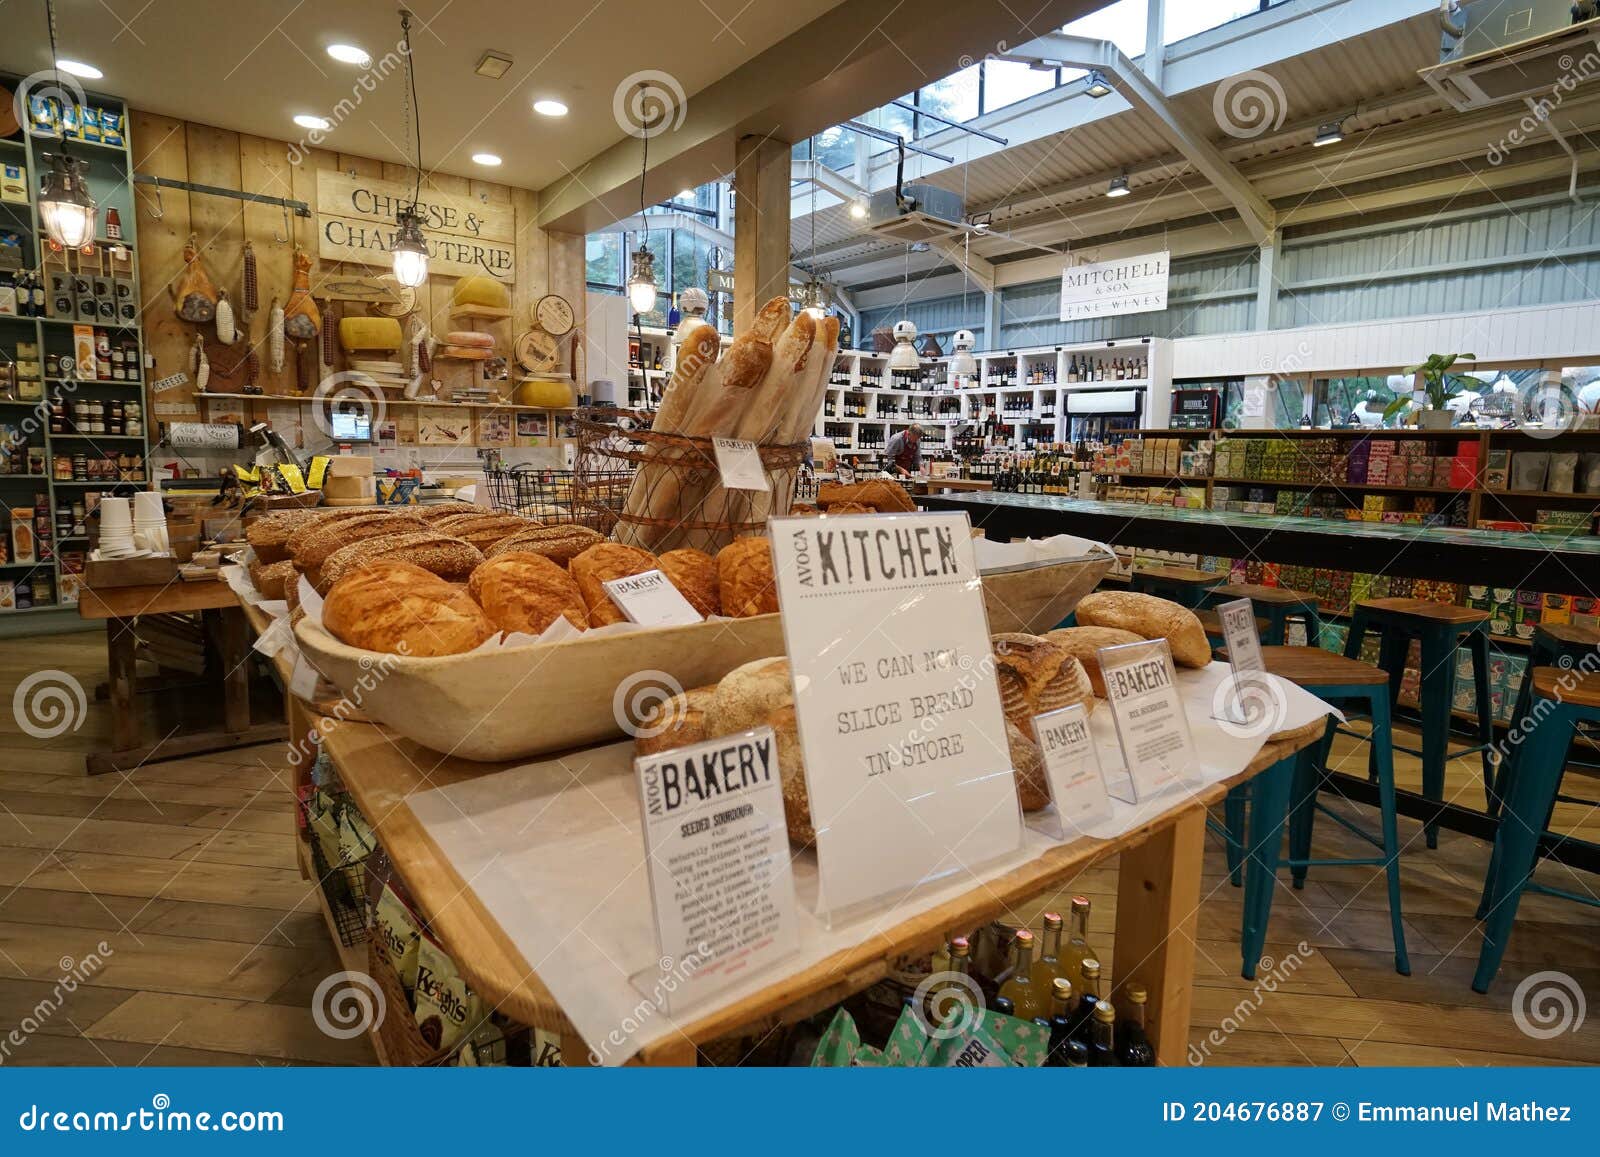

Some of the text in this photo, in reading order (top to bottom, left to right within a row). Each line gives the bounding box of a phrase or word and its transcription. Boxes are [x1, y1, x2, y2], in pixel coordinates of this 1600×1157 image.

[465, 212, 484, 236] &
[325, 221, 513, 277] CHAUTERIE
[1068, 261, 1166, 288] MITCHELL
[1107, 282, 1129, 293] SON
[1068, 296, 1161, 313] FINE WINES
[720, 440, 754, 450] BAKERY
[793, 526, 958, 588] AVOCA KITCHEN
[616, 574, 664, 593] BAKERY
[839, 648, 959, 685] WE CAN NOW
[1115, 660, 1170, 698] BAKERY
[837, 688, 974, 735] SLICE BREAD
[1045, 720, 1088, 750] BAKERY
[866, 734, 964, 777] IN STORE
[645, 738, 771, 816] AVOCA BAKERY
[681, 803, 754, 838] SEEDED SOURDOUGH
